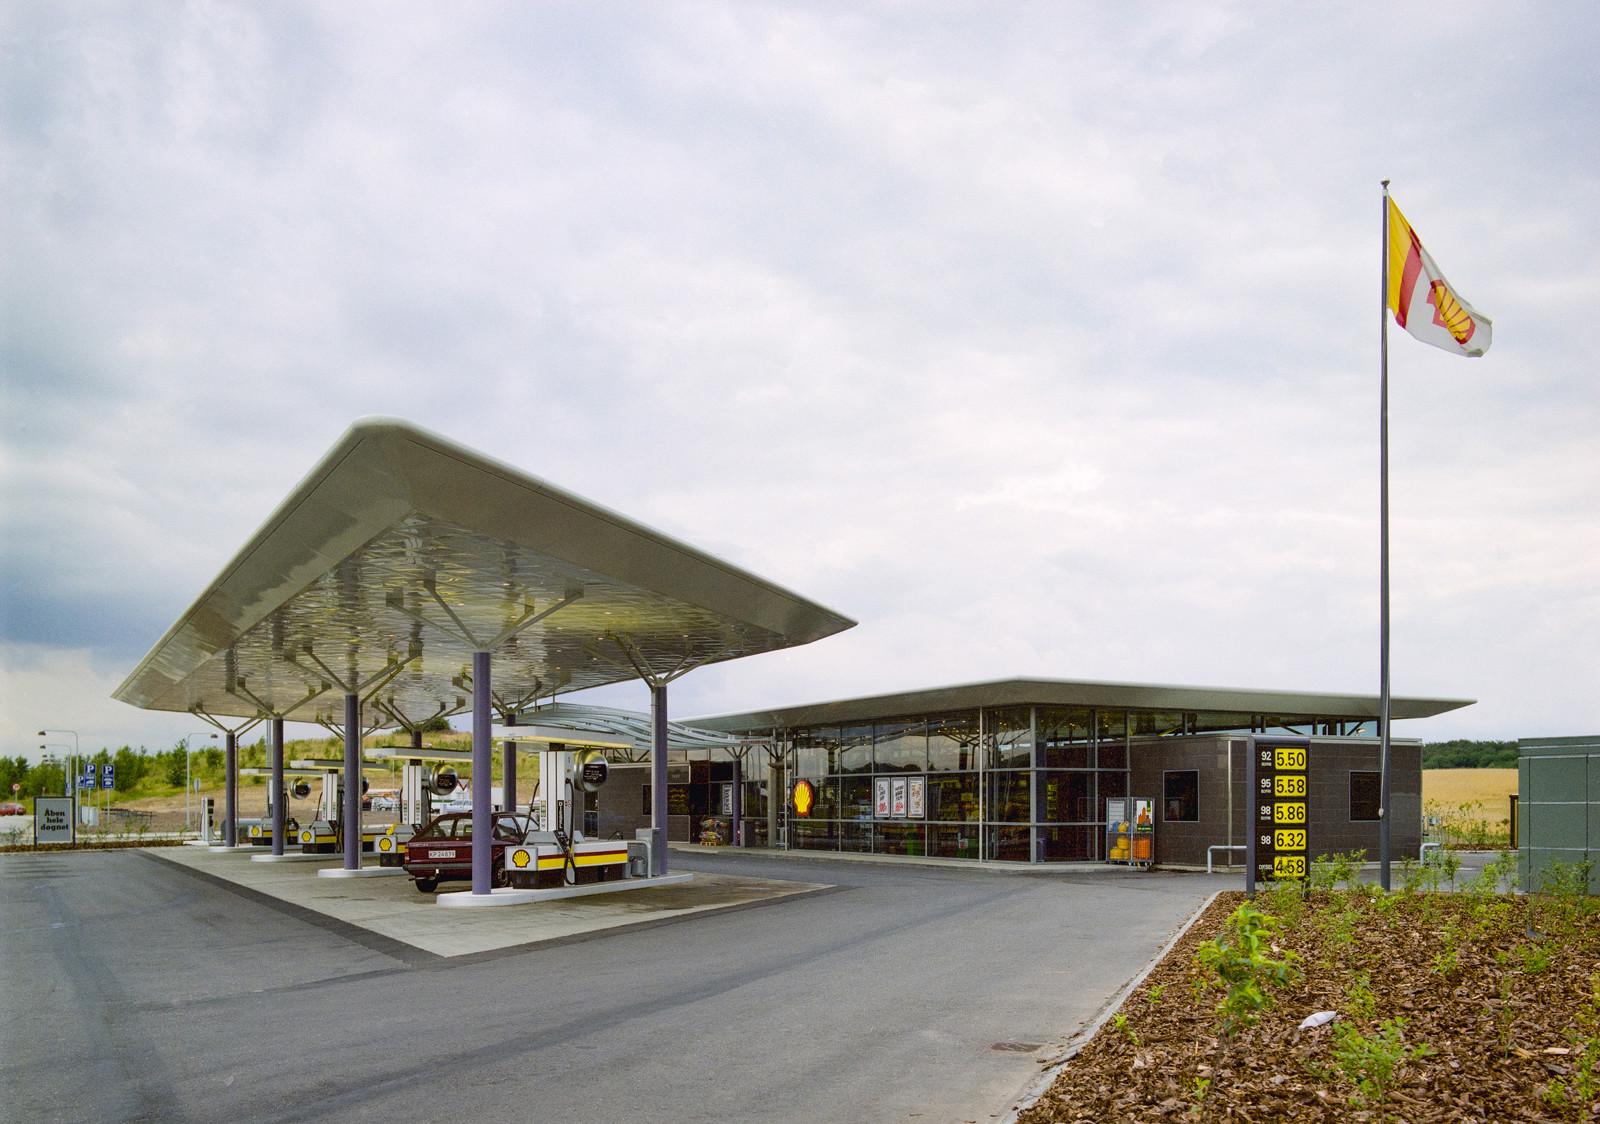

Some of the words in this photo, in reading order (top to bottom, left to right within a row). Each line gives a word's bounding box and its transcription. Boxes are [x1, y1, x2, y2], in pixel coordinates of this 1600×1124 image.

[1261, 751, 1272, 761] 92
[1276, 752, 1305, 767] 5.50
[1260, 778, 1272, 788] 95
[1276, 779, 1305, 794] 5.58
[44, 807, 65, 816] Åben
[1260, 805, 1271, 815] 98
[1276, 805, 1304, 820] 5.86
[1260, 835, 1272, 845] 98
[1276, 832, 1304, 847] 6.32
[1275, 859, 1304, 874] 4.58
